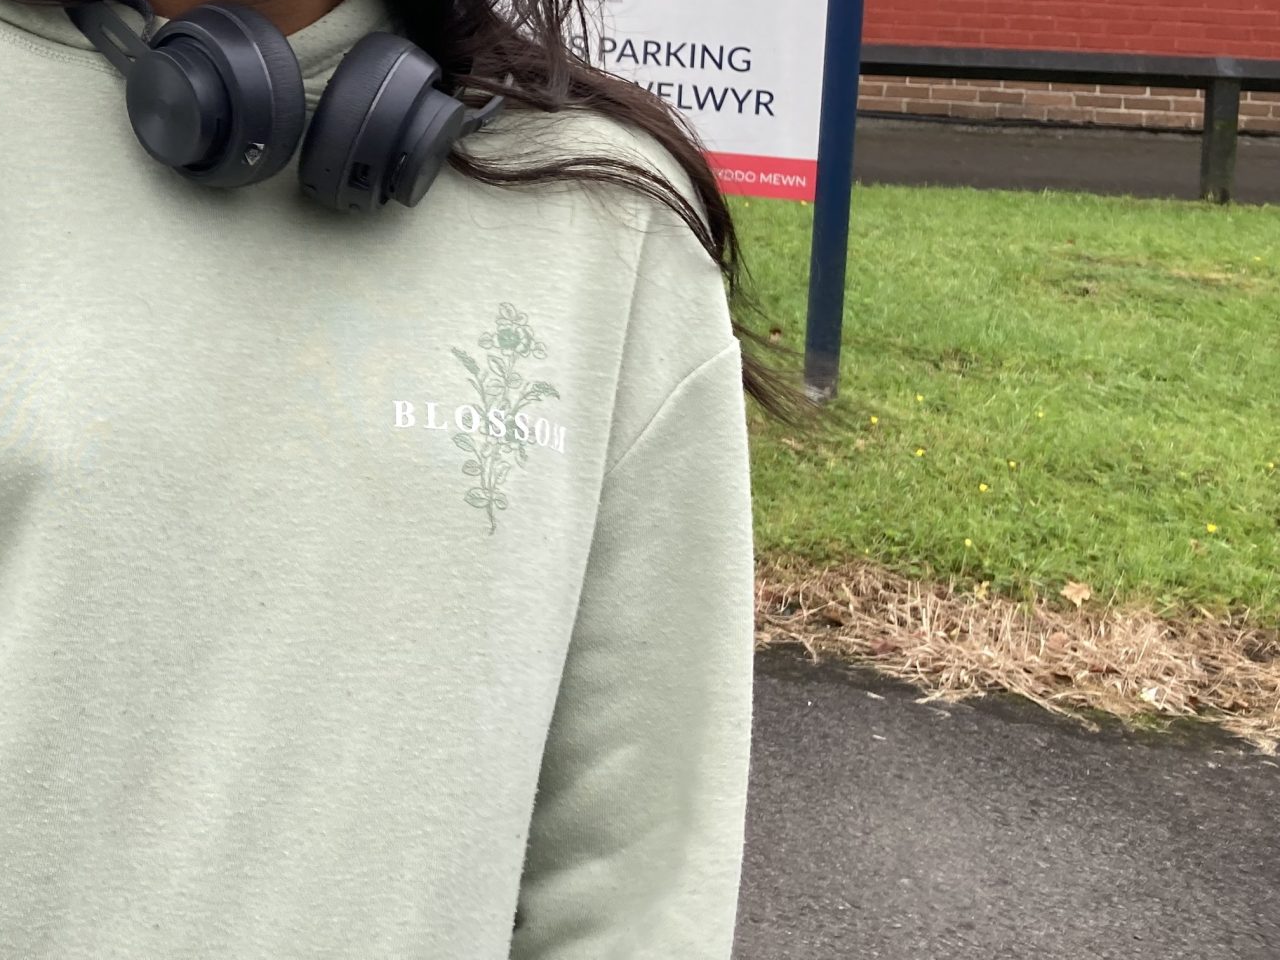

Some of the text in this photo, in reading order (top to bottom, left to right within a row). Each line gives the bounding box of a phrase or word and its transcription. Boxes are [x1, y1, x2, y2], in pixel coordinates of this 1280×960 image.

[598, 36, 753, 73] PARKING
[634, 81, 776, 117] ELWYR
[759, 171, 807, 188] MEWN
[392, 399, 568, 454] BLOSSOM
